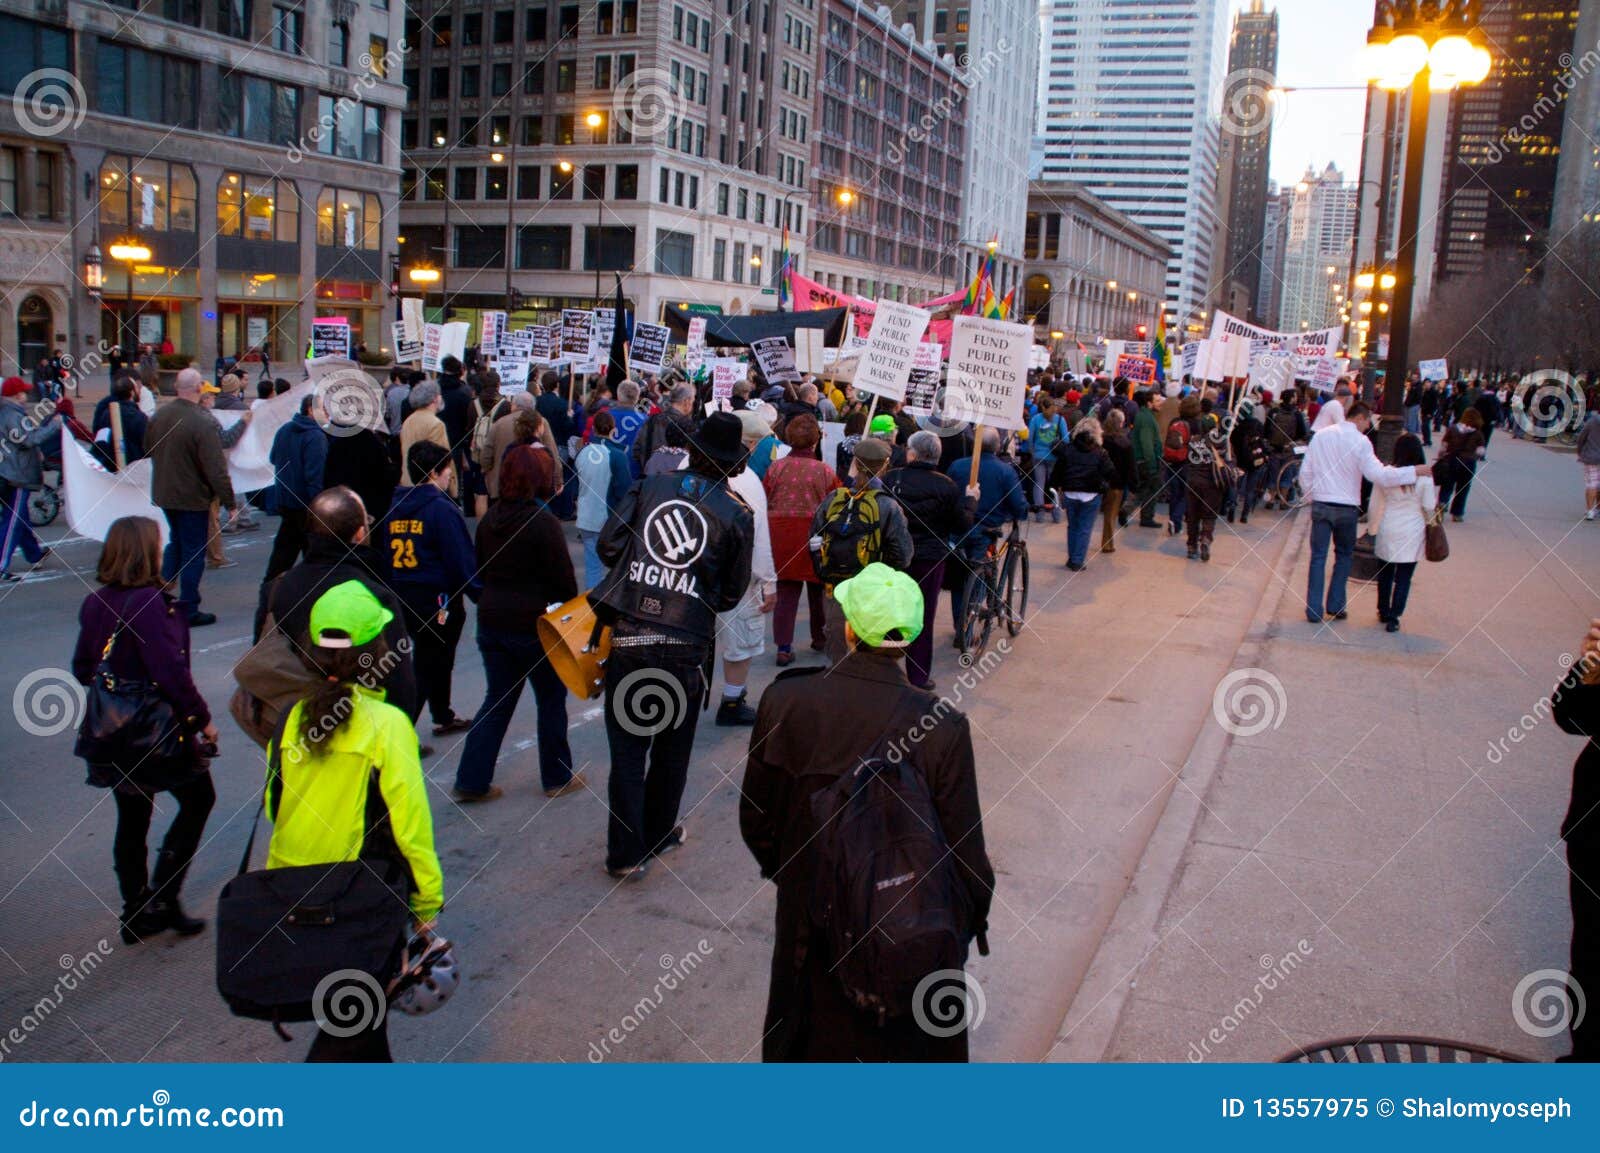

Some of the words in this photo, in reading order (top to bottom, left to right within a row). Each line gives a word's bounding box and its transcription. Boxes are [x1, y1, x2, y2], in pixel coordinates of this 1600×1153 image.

[887, 315, 912, 328] FUND
[880, 328, 910, 342] PUBLIC
[973, 334, 1009, 350] FUND
[871, 340, 910, 357] SERVICES
[967, 348, 1012, 366] PUBLIC
[716, 366, 730, 374] Stop
[868, 352, 888, 366] NOT
[887, 356, 906, 370] THE
[869, 367, 896, 383] WARS!
[958, 362, 1016, 382] SERVICES
[958, 376, 986, 392] NOT
[986, 382, 1013, 398] THE
[965, 392, 1004, 410] WARS!
[390, 538, 418, 568] 23
[630, 561, 700, 598] SIGNAL
